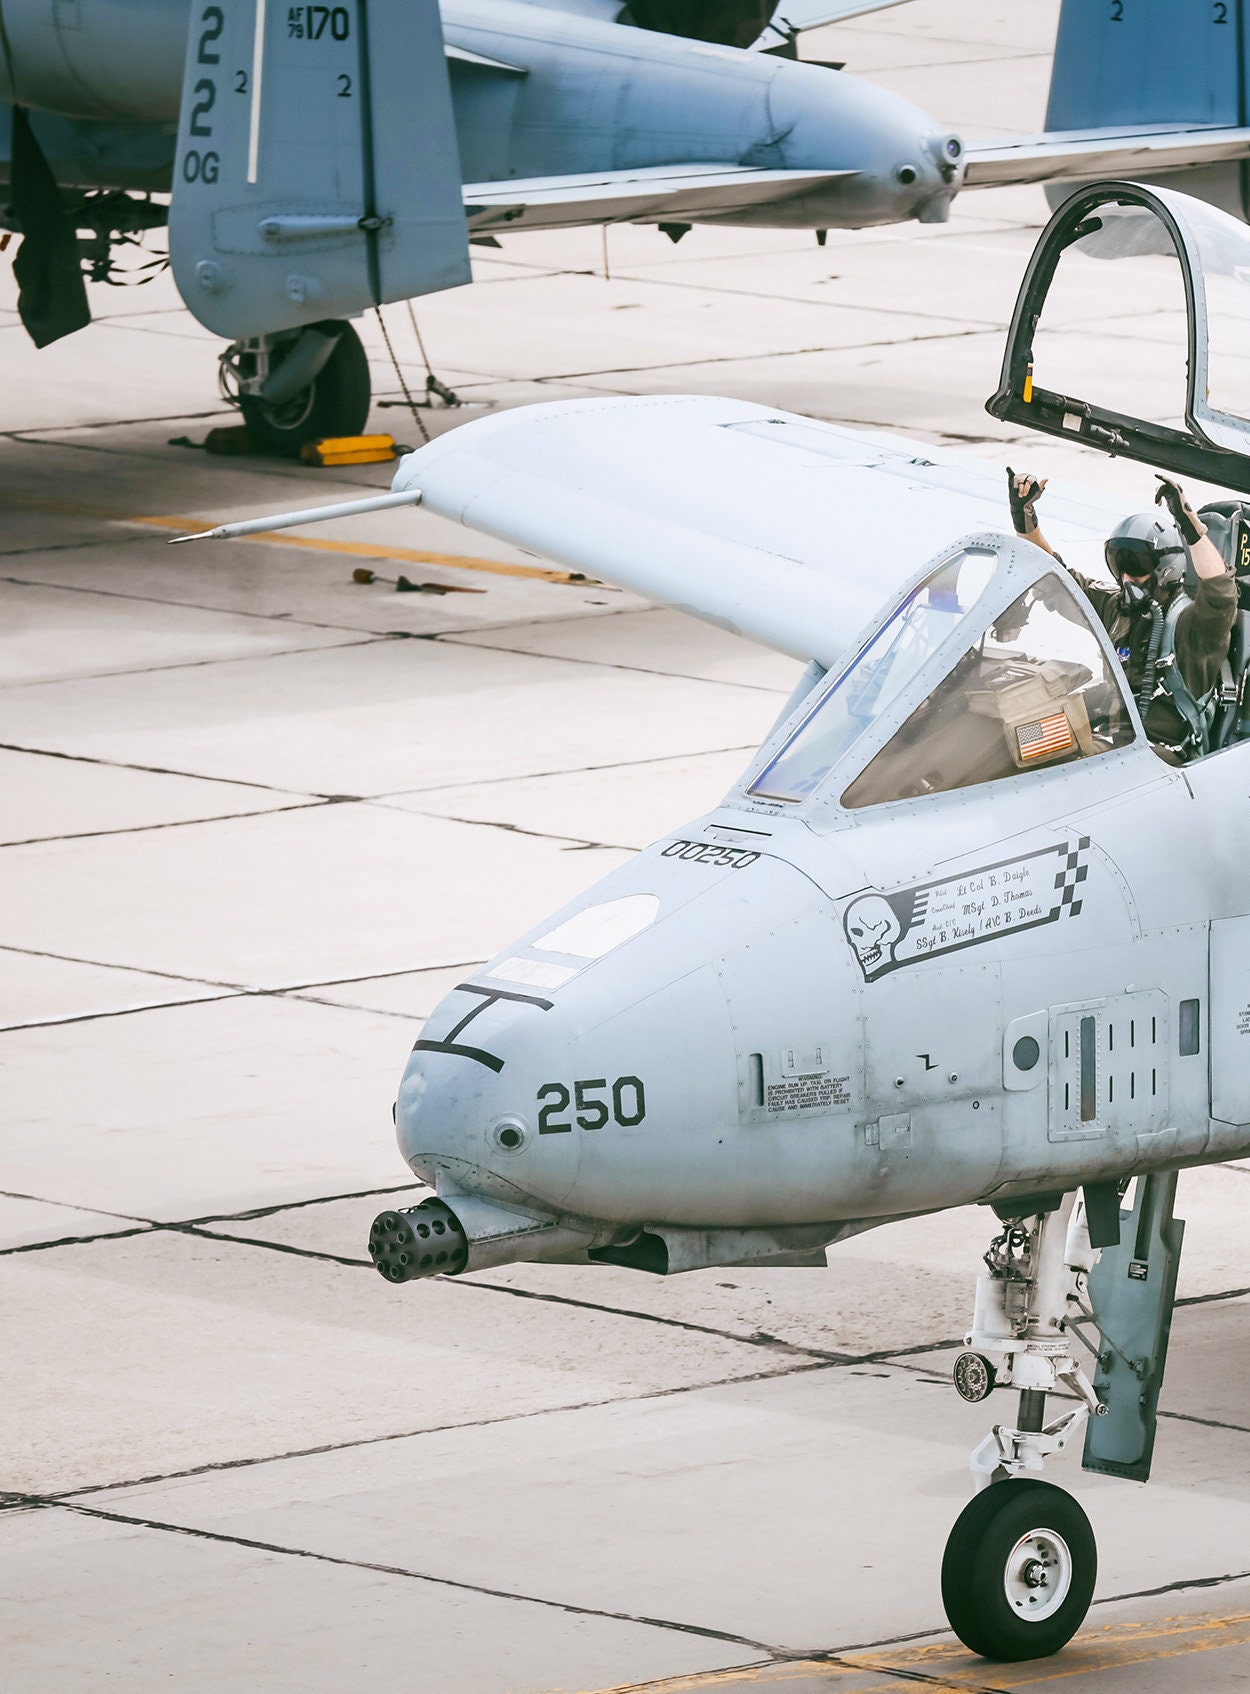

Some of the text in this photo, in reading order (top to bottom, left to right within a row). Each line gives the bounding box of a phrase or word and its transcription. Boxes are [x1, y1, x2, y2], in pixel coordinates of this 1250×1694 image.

[1111, 0, 1123, 21] 2
[1213, 2, 1227, 24] 2
[307, 5, 349, 41] 170
[234, 70, 247, 94] 2
[337, 74, 352, 97] 2
[183, 150, 220, 184] OG
[1241, 533, 1248, 550] P
[1241, 548, 1250, 566] 15
[660, 840, 762, 870] 00250
[962, 900, 985, 916] MSgt
[1003, 889, 1033, 904] Thomas
[916, 935, 937, 951] SSgt
[537, 1075, 646, 1135] 250
